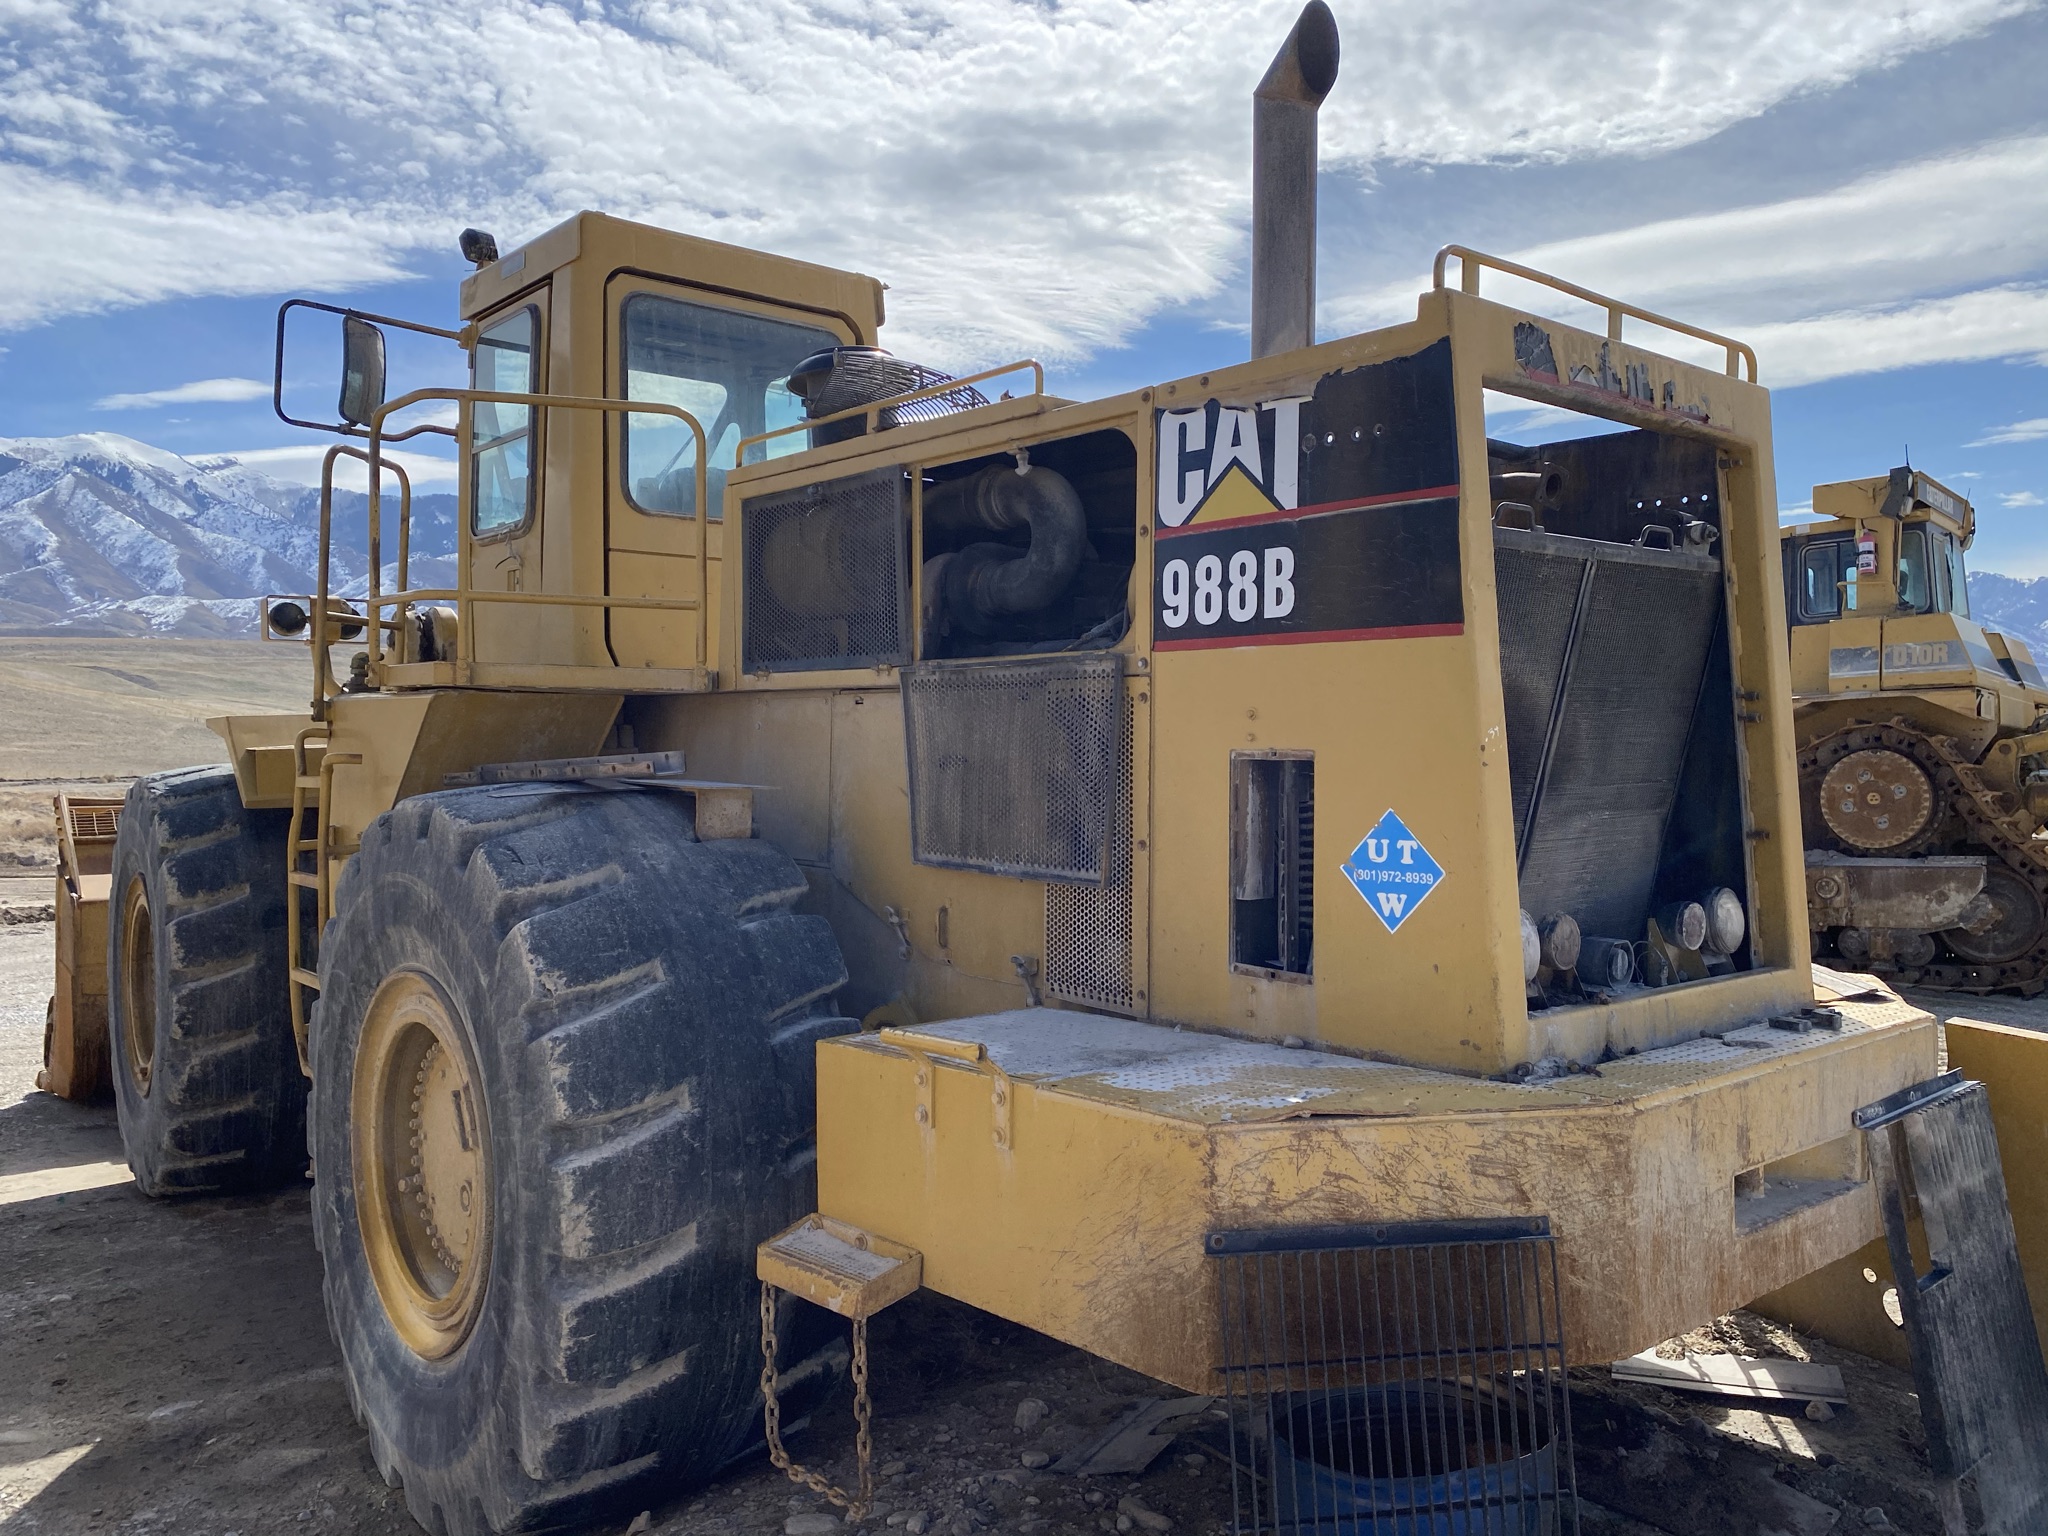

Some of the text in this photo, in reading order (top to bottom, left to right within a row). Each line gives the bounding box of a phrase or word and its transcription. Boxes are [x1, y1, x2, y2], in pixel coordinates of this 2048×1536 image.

[1159, 395, 1312, 527] CAT
[1162, 546, 1295, 629] 988B
[1892, 643, 1949, 667] D10R
[1376, 892, 1408, 918] W
